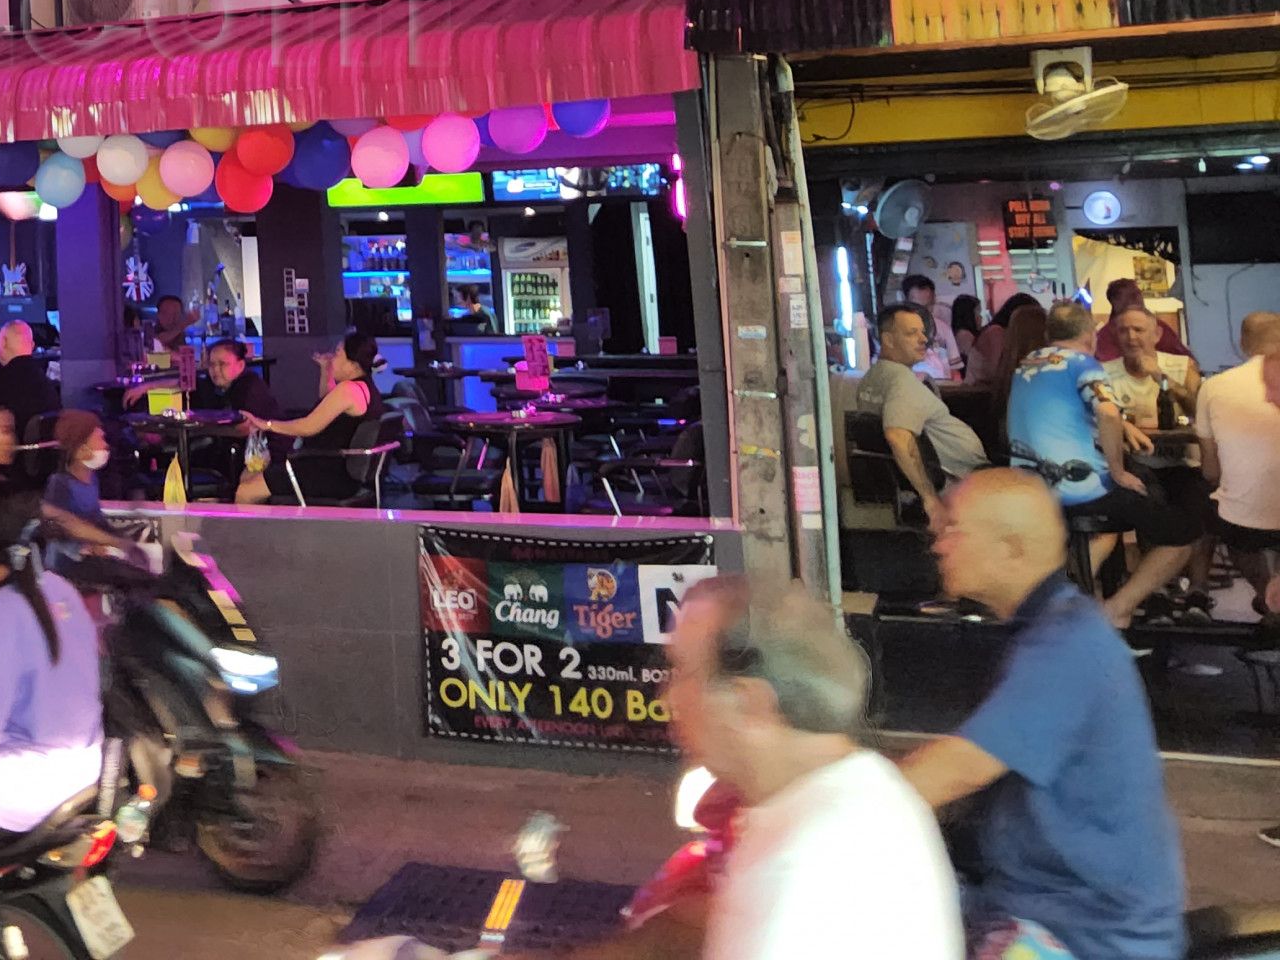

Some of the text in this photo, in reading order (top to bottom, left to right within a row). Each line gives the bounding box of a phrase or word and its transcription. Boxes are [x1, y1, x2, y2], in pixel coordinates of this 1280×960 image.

[431, 589, 476, 610] LEO
[494, 599, 560, 629] Chang
[572, 602, 637, 639] Tiger
[441, 637, 462, 671] 3
[475, 639, 546, 678] FOR
[558, 646, 583, 680] 2
[438, 676, 533, 713] ONLY
[548, 685, 614, 720] 140
